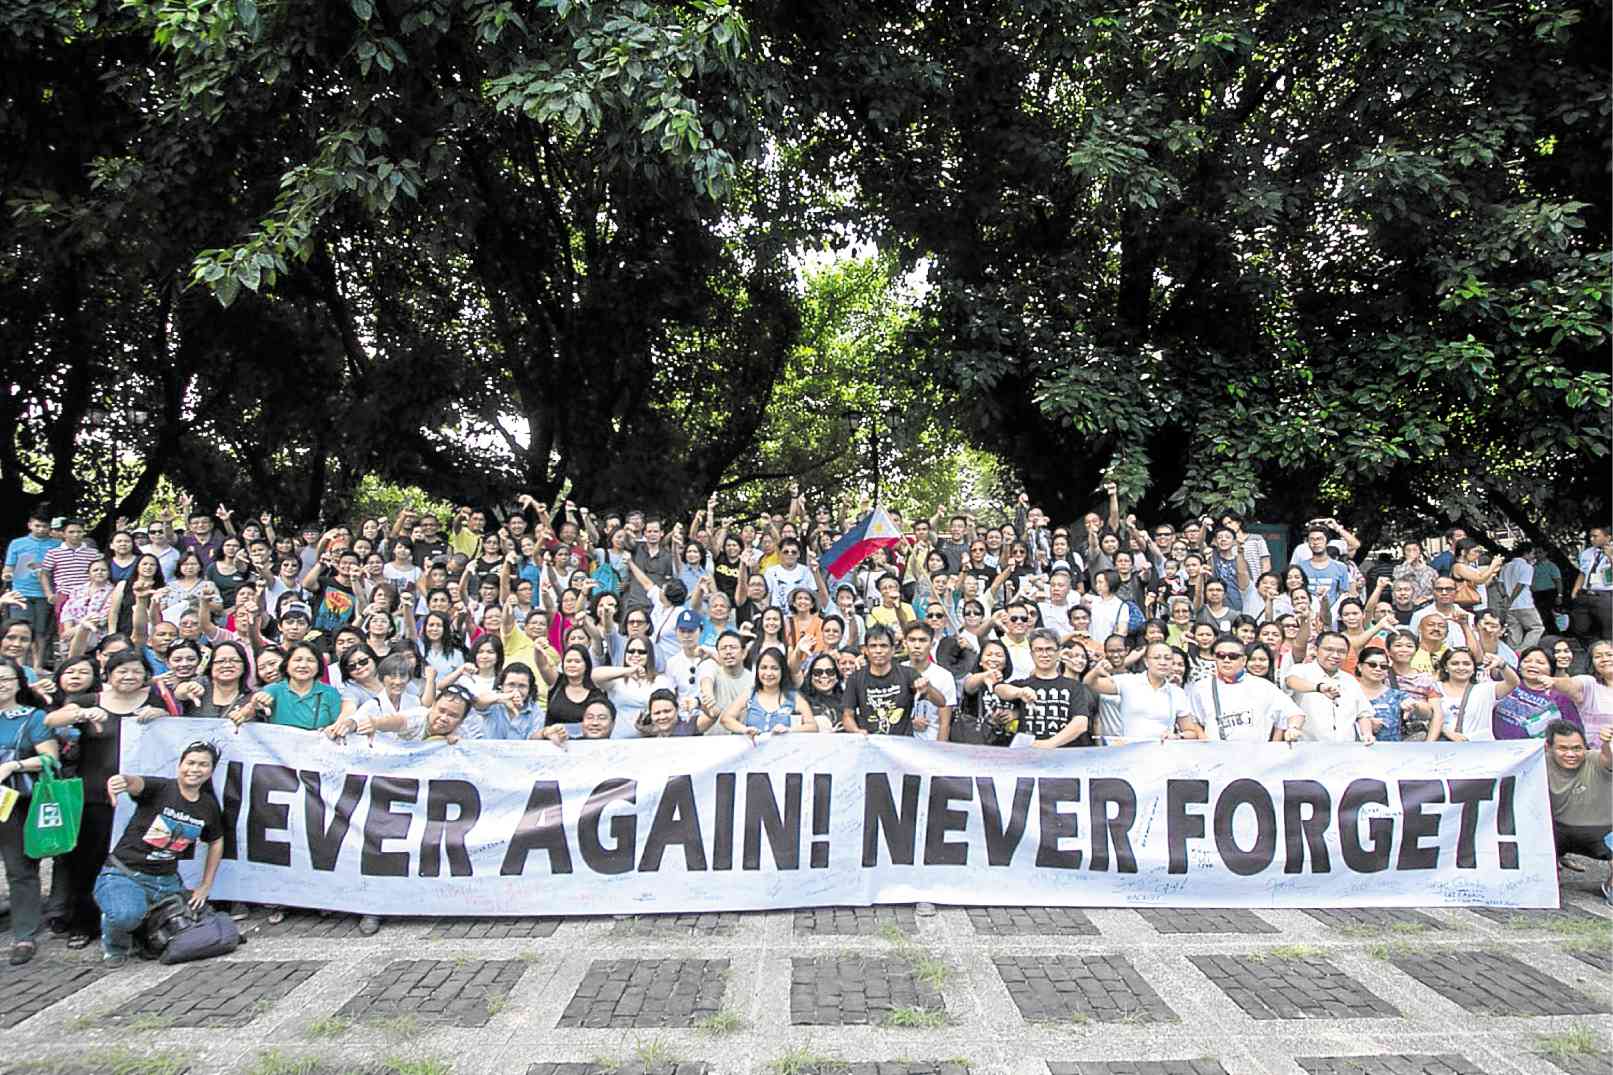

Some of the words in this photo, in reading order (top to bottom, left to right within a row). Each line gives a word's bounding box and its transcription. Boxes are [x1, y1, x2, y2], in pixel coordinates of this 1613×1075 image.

[500, 772, 832, 876] AGAIN!
[862, 772, 1138, 874] NEVER
[1167, 776, 1519, 876] FORGET!
